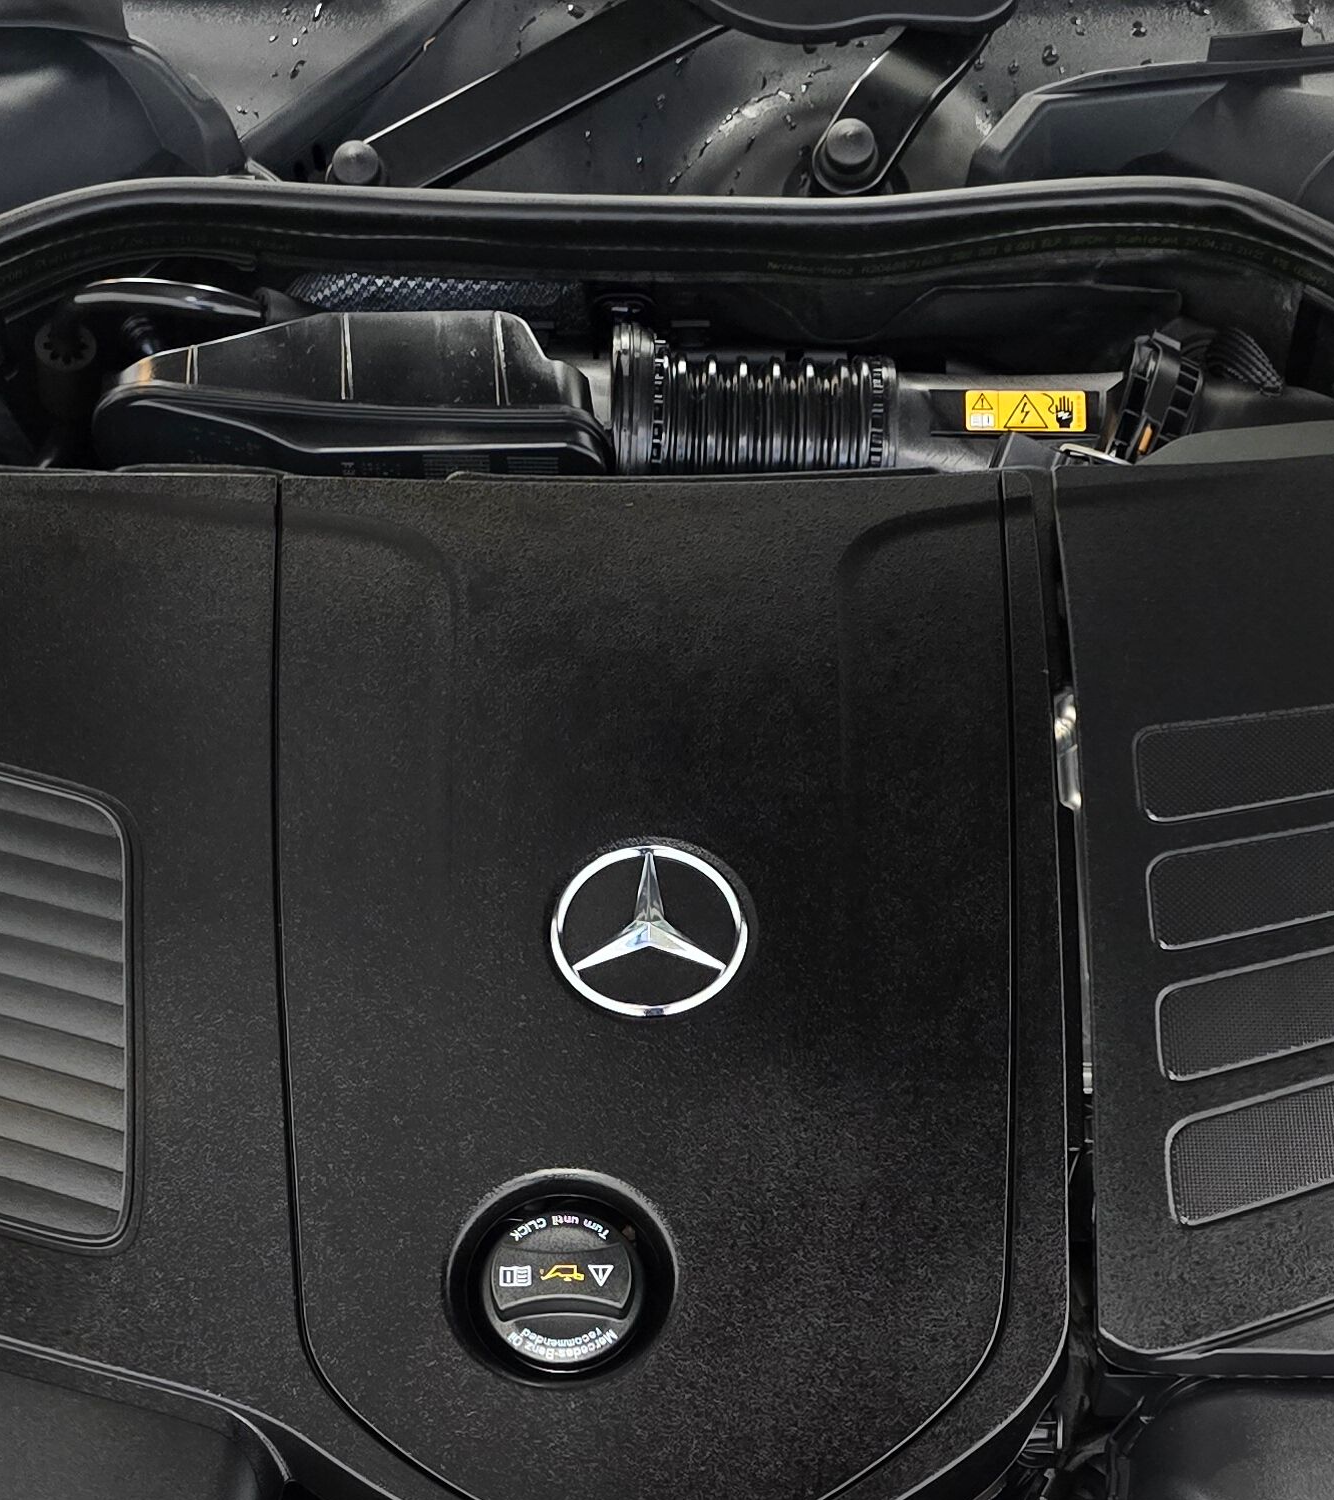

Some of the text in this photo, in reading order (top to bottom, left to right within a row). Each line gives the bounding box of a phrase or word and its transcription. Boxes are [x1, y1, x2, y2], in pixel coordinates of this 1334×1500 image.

[509, 1215, 611, 1241] Turn until CLICK
[507, 1328, 618, 1360] Mercedes-Benz Oil
[520, 1327, 602, 1347] recommended
